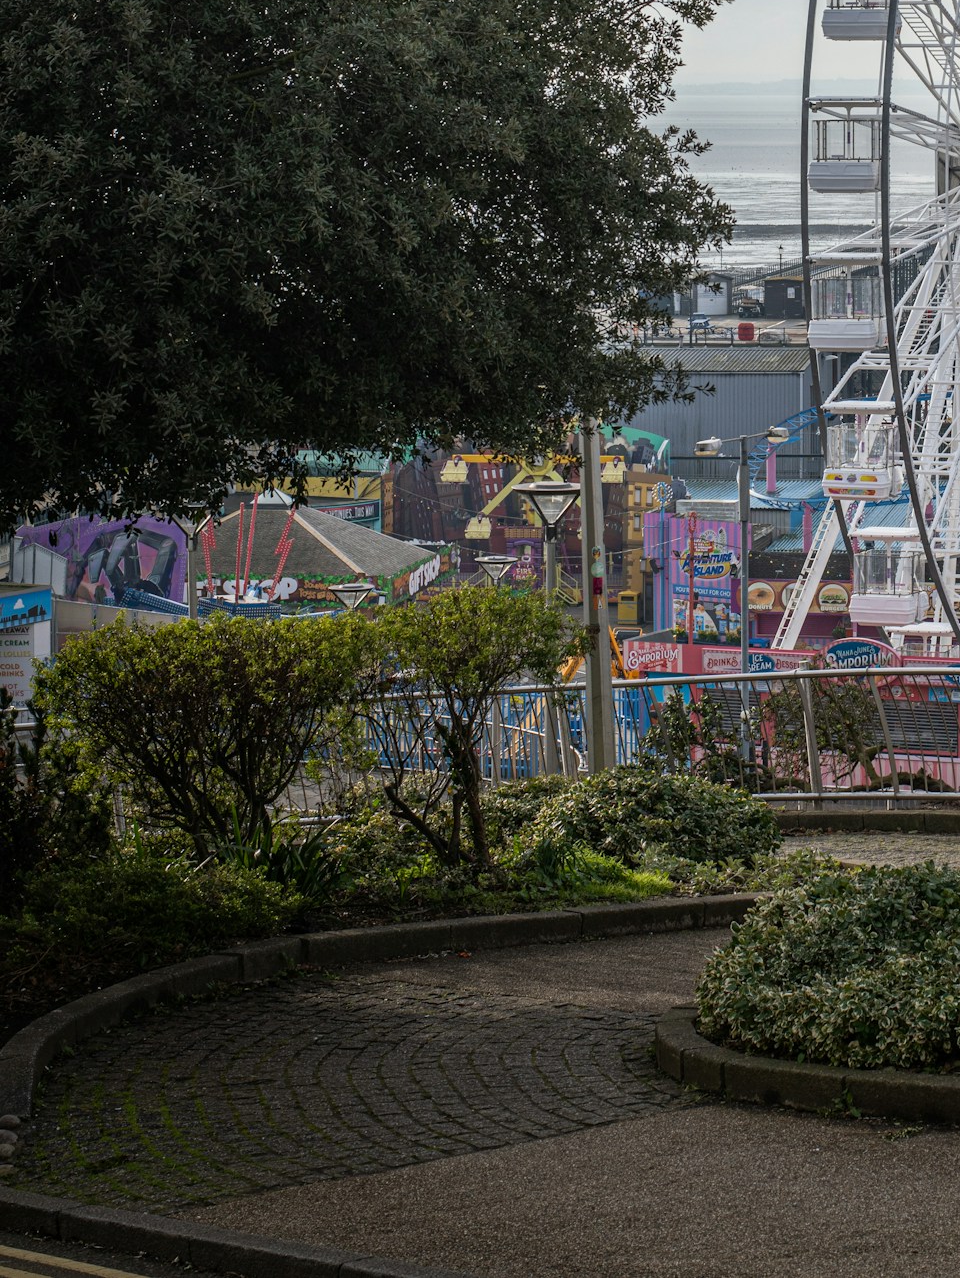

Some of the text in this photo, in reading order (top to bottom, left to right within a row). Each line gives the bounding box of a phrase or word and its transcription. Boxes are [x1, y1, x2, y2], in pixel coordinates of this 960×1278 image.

[408, 554, 441, 596] GIFT SHOP
[627, 649, 679, 669] EMPORIUM
[752, 653, 764, 663] ICE
[826, 652, 893, 669] EMPORIUM
[836, 649, 854, 658] NANA
[707, 657, 739, 668] DRINKS
